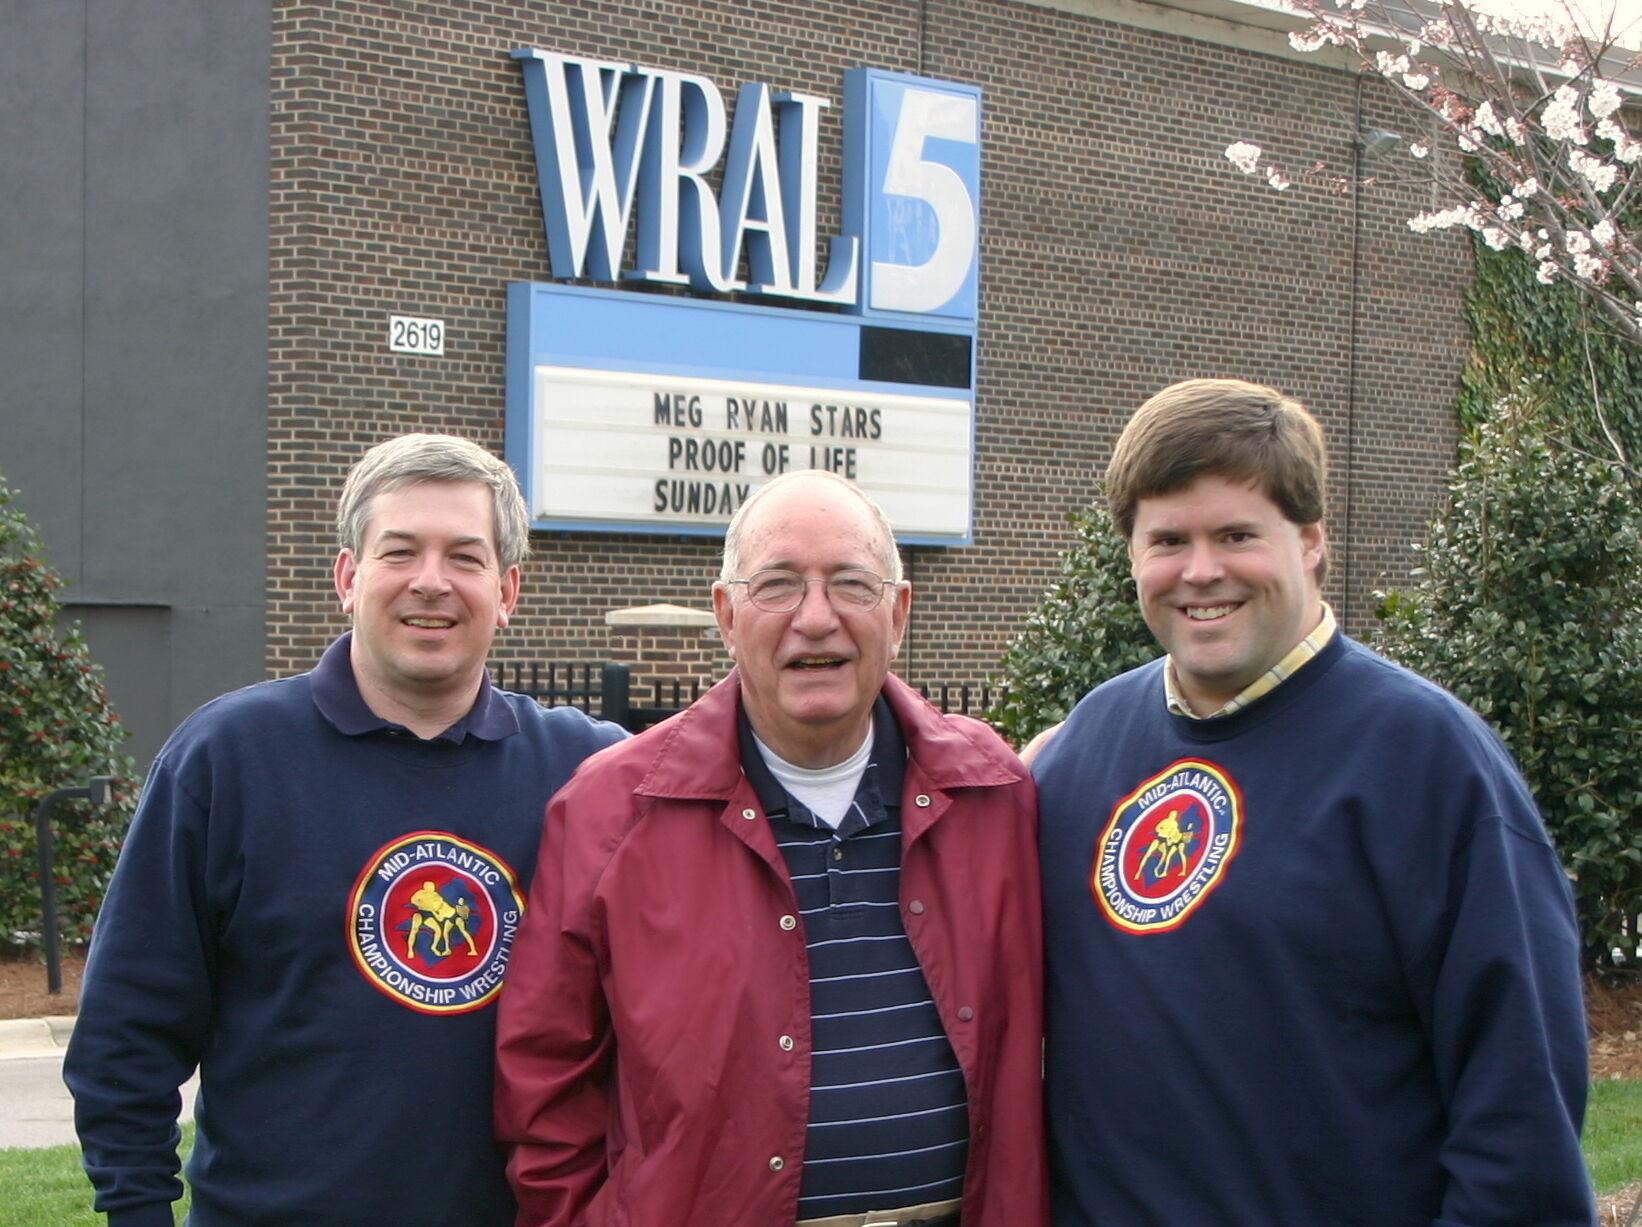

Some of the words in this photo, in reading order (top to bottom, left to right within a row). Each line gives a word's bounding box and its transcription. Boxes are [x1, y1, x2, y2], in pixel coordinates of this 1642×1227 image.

[526, 47, 859, 305] WRAL
[870, 88, 976, 313] 5
[394, 320, 441, 350] 2619
[654, 392, 702, 428] MEG
[726, 397, 788, 434] RYAN
[810, 403, 882, 440] STARS
[668, 437, 746, 473] PROOF
[762, 442, 789, 475] OF
[654, 478, 750, 516] SUNDAY
[1138, 771, 1226, 811] MID-ATLANTIC
[378, 843, 500, 885] MID-ATLANTIC
[1100, 828, 1156, 923] CHAMPIONSHIP
[1160, 833, 1229, 920] WRESTLING
[358, 904, 455, 1004] CHAMPIONSHIP
